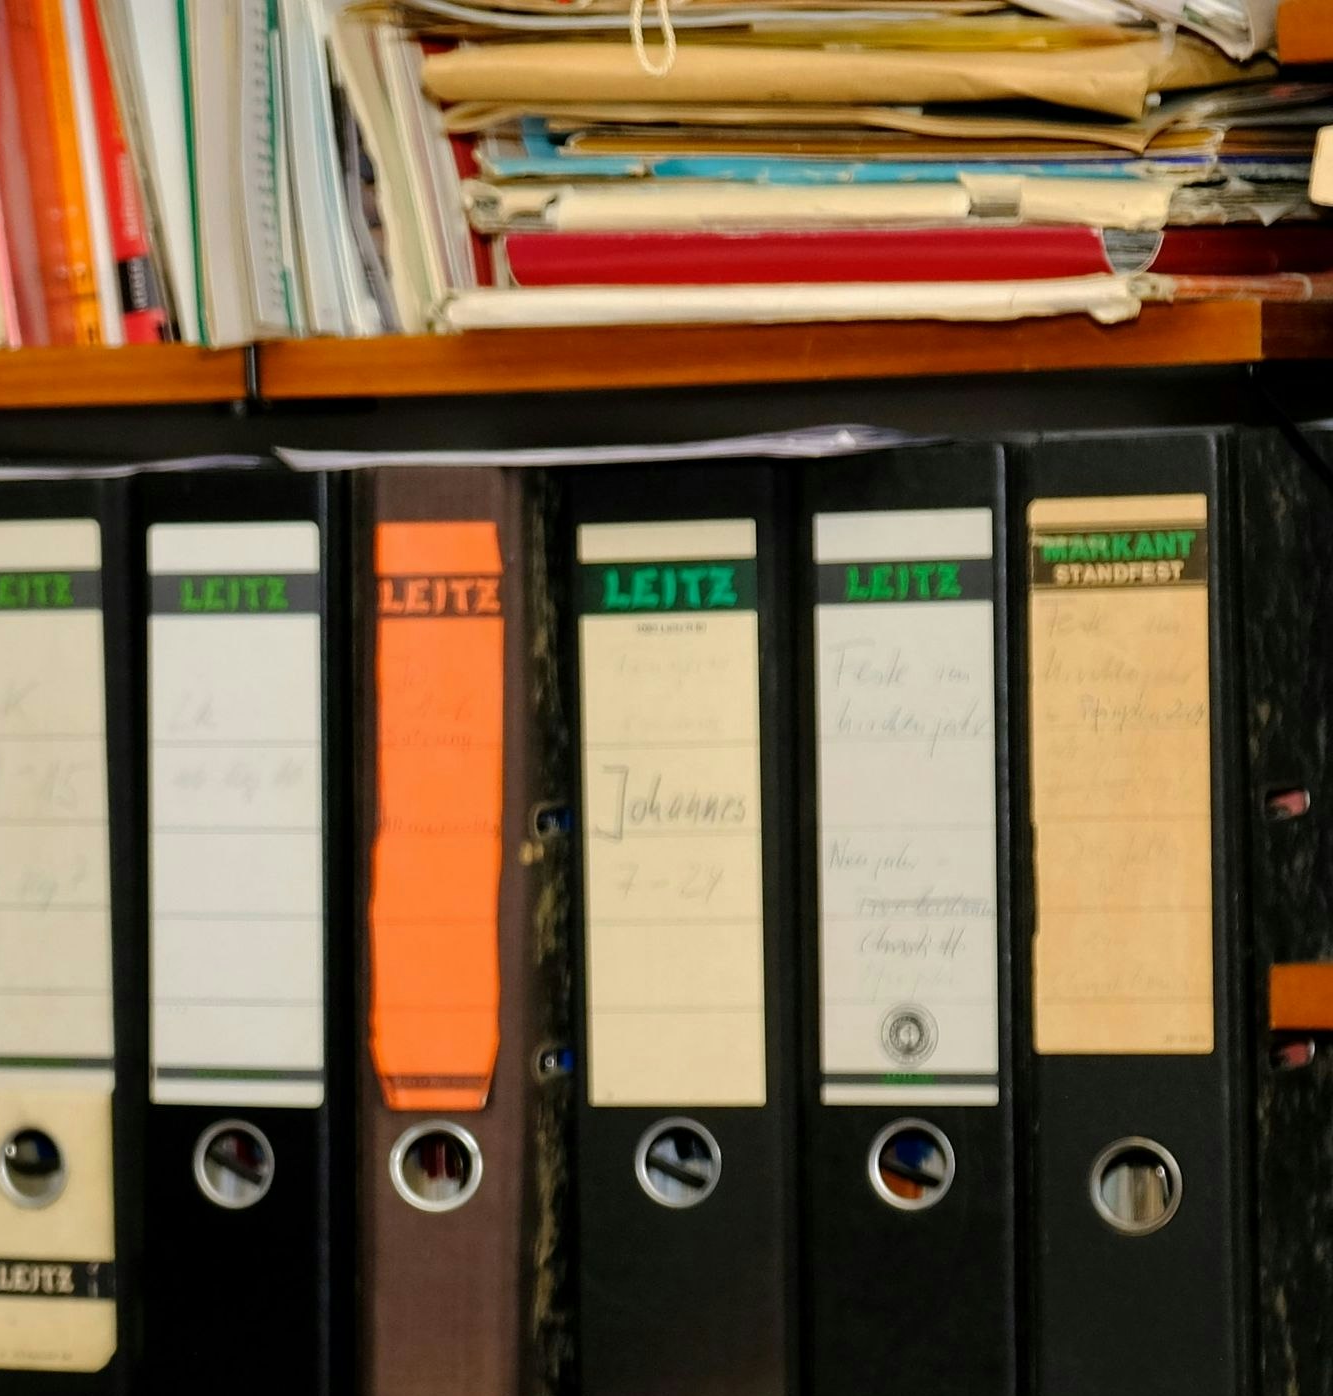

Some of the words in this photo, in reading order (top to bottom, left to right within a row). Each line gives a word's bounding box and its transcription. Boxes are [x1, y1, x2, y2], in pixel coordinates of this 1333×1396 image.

[1042, 531, 1196, 561] MARKANT
[603, 566, 738, 609] LEITZ
[846, 564, 962, 599] LEITZ
[1053, 561, 1185, 586] STANDFEST
[180, 577, 288, 611] LEITZ
[379, 576, 502, 614] LEITZ
[596, 765, 746, 842] Johannes
